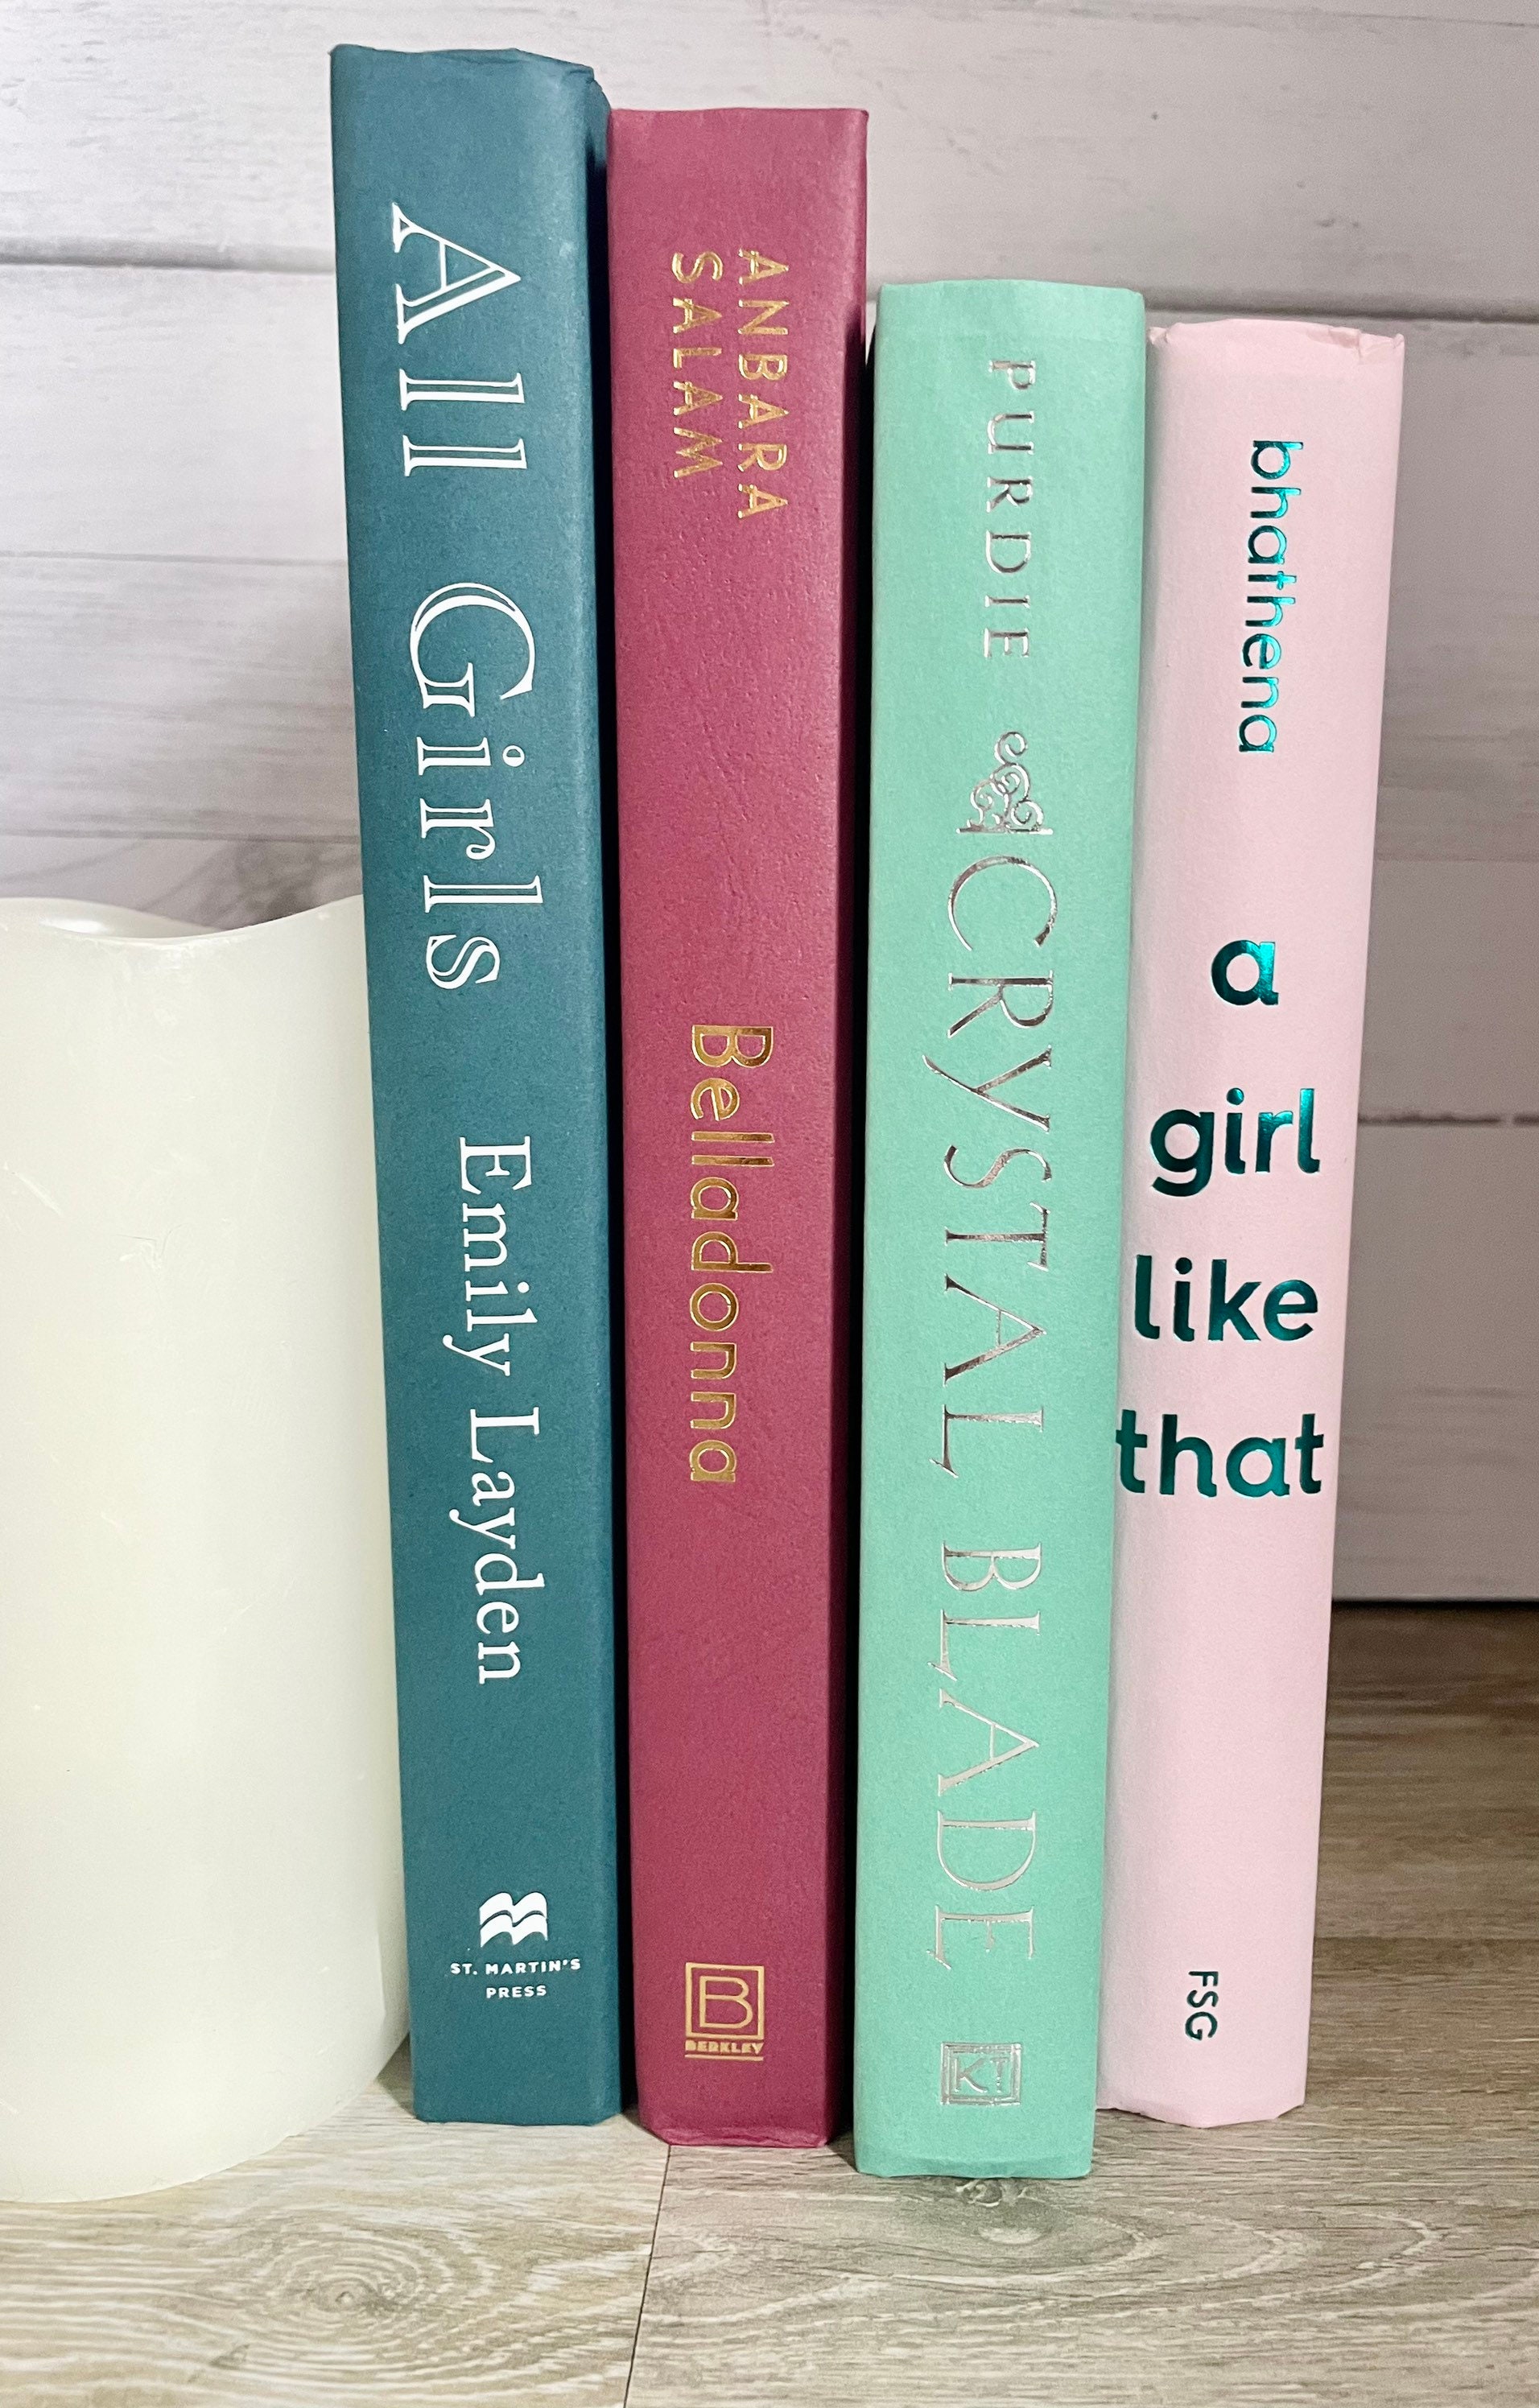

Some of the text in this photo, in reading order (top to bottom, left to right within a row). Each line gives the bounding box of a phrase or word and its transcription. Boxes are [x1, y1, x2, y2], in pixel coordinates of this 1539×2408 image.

[671, 251, 724, 479] SALAM
[738, 248, 789, 520] ANBARA
[984, 360, 1036, 658] PURDIE
[391, 203, 544, 990] All Girls
[1239, 440, 1303, 752] bhathena
[1211, 939, 1279, 1006] a
[1149, 1087, 1320, 1198] girl
[689, 1025, 774, 1482] Belladonna
[1134, 1254, 1318, 1342] like
[444, 1136, 545, 1684] Emily Layden
[922, 855, 1058, 1970] CRYSTAL BLADE
[1116, 1408, 1324, 1498] that
[450, 1958, 581, 1975] ST. MARTIN'S
[486, 1985, 547, 1998] PRESS
[685, 2039, 764, 2055] BERKLEY
[1185, 1970, 1219, 2041] FSG
